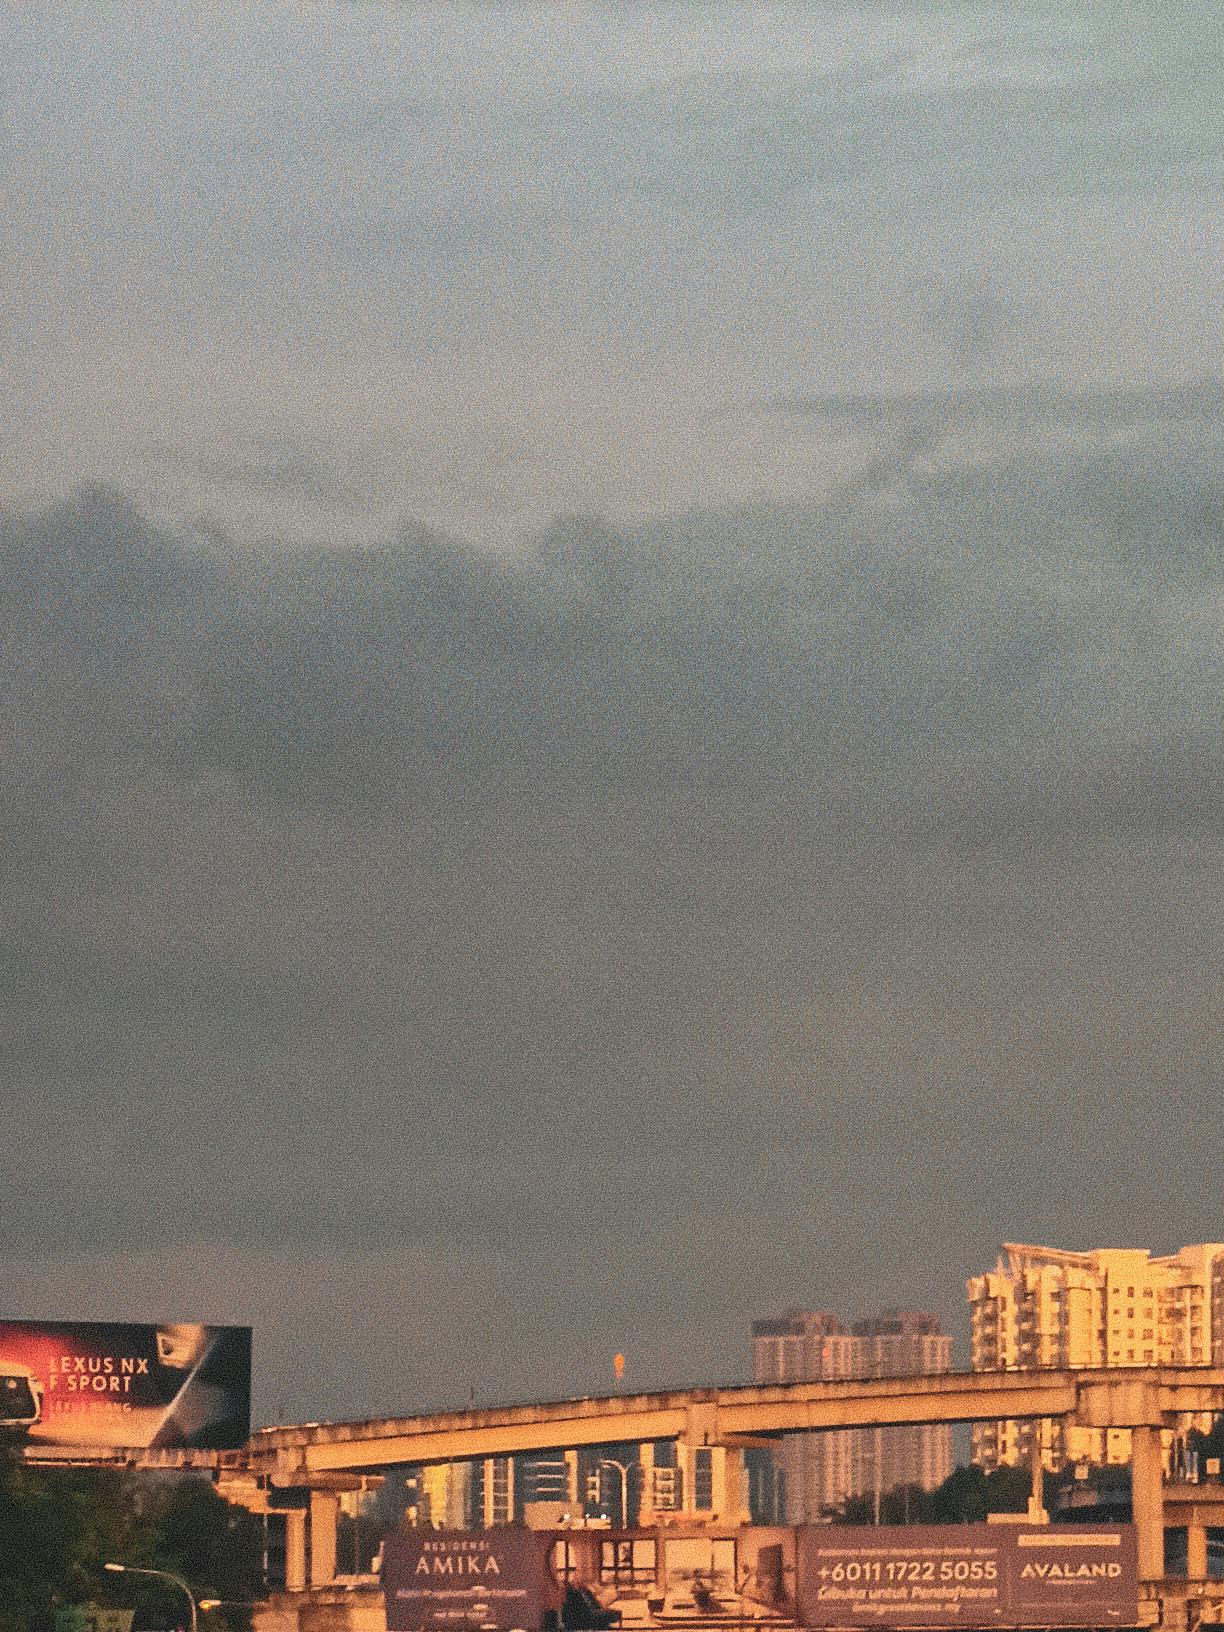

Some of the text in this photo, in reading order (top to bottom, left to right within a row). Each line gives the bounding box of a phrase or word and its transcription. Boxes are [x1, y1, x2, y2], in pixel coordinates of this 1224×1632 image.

[50, 1356, 149, 1374] LEXUS NX
[49, 1375, 132, 1392] F SPORT
[415, 1555, 501, 1575] AMIKA
[817, 1561, 998, 1581] +6011 1722 5055
[1021, 1562, 1122, 1579] AVALAND
